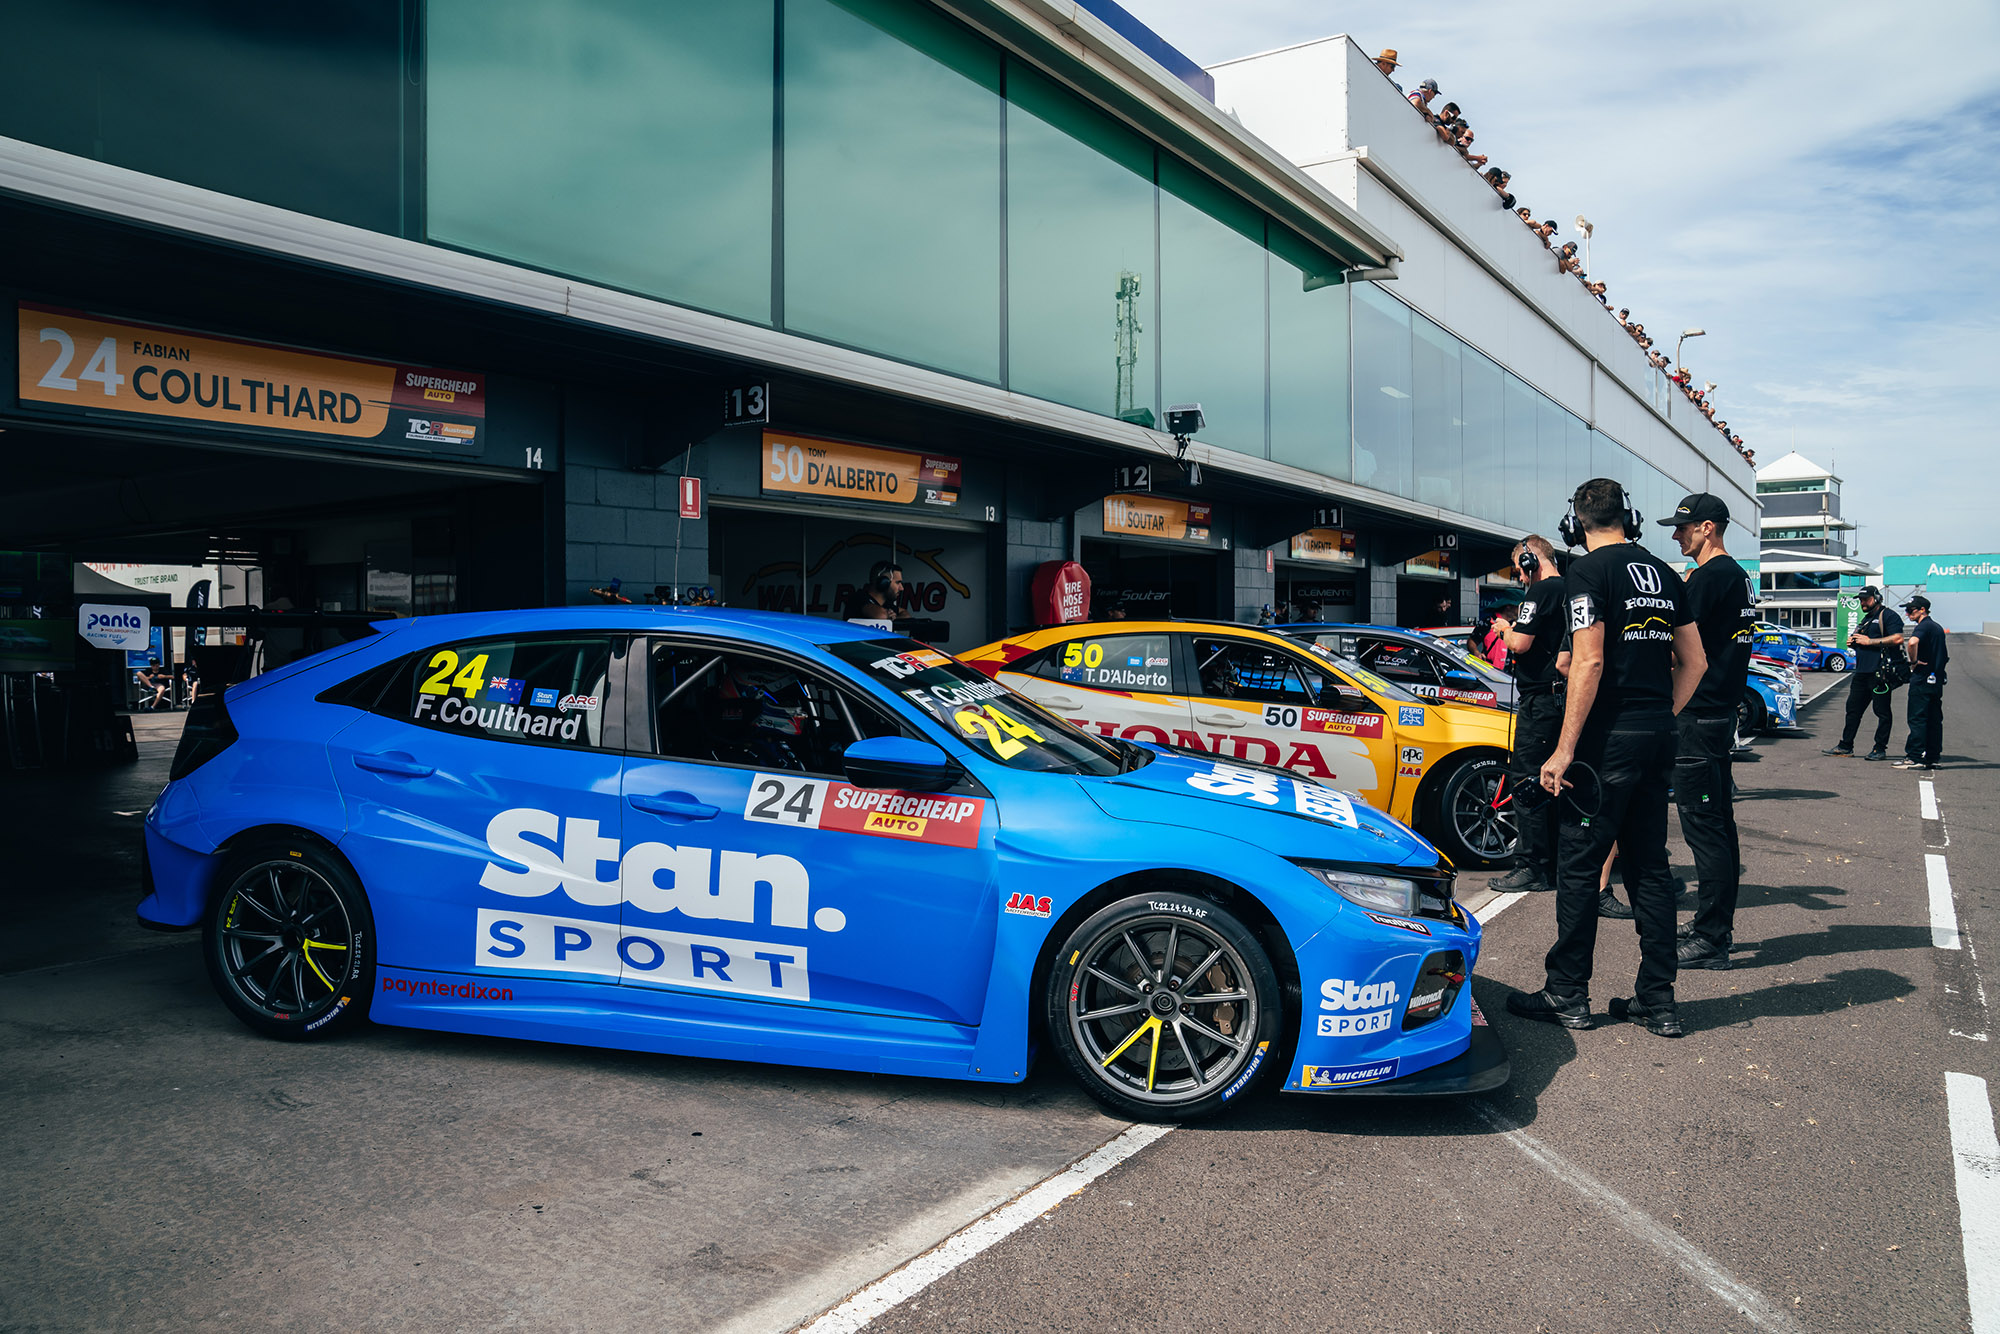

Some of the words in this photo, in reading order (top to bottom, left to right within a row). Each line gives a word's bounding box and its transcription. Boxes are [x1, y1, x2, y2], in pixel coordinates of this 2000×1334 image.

[133, 341, 190, 362] FABIAN
[36, 327, 125, 396] 24
[405, 372, 477, 395] SUPERCHEAP
[132, 365, 362, 424] COULTHARD
[427, 392, 452, 400] AUTO
[731, 386, 765, 417] 13
[408, 418, 444, 435] TCR
[526, 447, 542, 469] 14
[808, 447, 826, 458] TONY
[770, 442, 804, 484] 50
[808, 462, 898, 494] D'ALBERTO
[1120, 465, 1148, 487] 12
[984, 505, 995, 521] 13
[1106, 499, 1126, 527] 110
[1127, 511, 1165, 531] SOUTAR
[1318, 508, 1338, 524] 11
[1221, 538, 1228, 549] 12
[1437, 534, 1456, 547] 10
[1927, 562, 2000, 576] Australia
[134, 577, 148, 585] TRUST
[1064, 581, 1082, 594] FIRE
[833, 581, 948, 612] RNG
[1063, 592, 1083, 607] HOSE
[1120, 589, 1172, 600] Soutar
[1297, 588, 1353, 597] CLEMENTE
[1063, 605, 1083, 619] REEL
[1520, 607, 1530, 620] 50
[1624, 597, 1675, 611] HONDA
[1740, 608, 1755, 617] HON
[87, 612, 141, 629] panta
[1573, 605, 1585, 627] 24
[1623, 631, 1648, 641] WALL
[1063, 642, 1104, 668] 50
[419, 650, 489, 699] 24
[870, 653, 931, 680] TCR
[1086, 668, 1096, 683] T.
[1099, 668, 1168, 687] D'Alberto
[565, 695, 597, 705] ARG
[1412, 685, 1437, 698] 110
[1441, 688, 1494, 702] SUPERCHEAP
[414, 693, 582, 741] F.Coulthard
[1264, 706, 1298, 728] 50
[1306, 710, 1380, 728] SUPERCHEAP
[954, 704, 1046, 761] 24
[1327, 724, 1353, 732] AUTO
[1402, 748, 1422, 762] PPG
[1399, 766, 1421, 776] JAS
[751, 780, 816, 823] 24
[833, 787, 976, 824] SUPERCHEAP
[871, 816, 920, 832] AUTO
[479, 807, 847, 933] Stan.
[1006, 893, 1052, 914] JAS
[487, 920, 795, 989] SPORT
[382, 977, 513, 1001] paynterdixon
[1319, 978, 1400, 1011] Stan.
[307, 1005, 340, 1031] MICHELIN
[1320, 1012, 1391, 1033] SPORT
[1224, 1058, 1261, 1099] MICHELIN
[1333, 1065, 1393, 1081] MICHELIN
